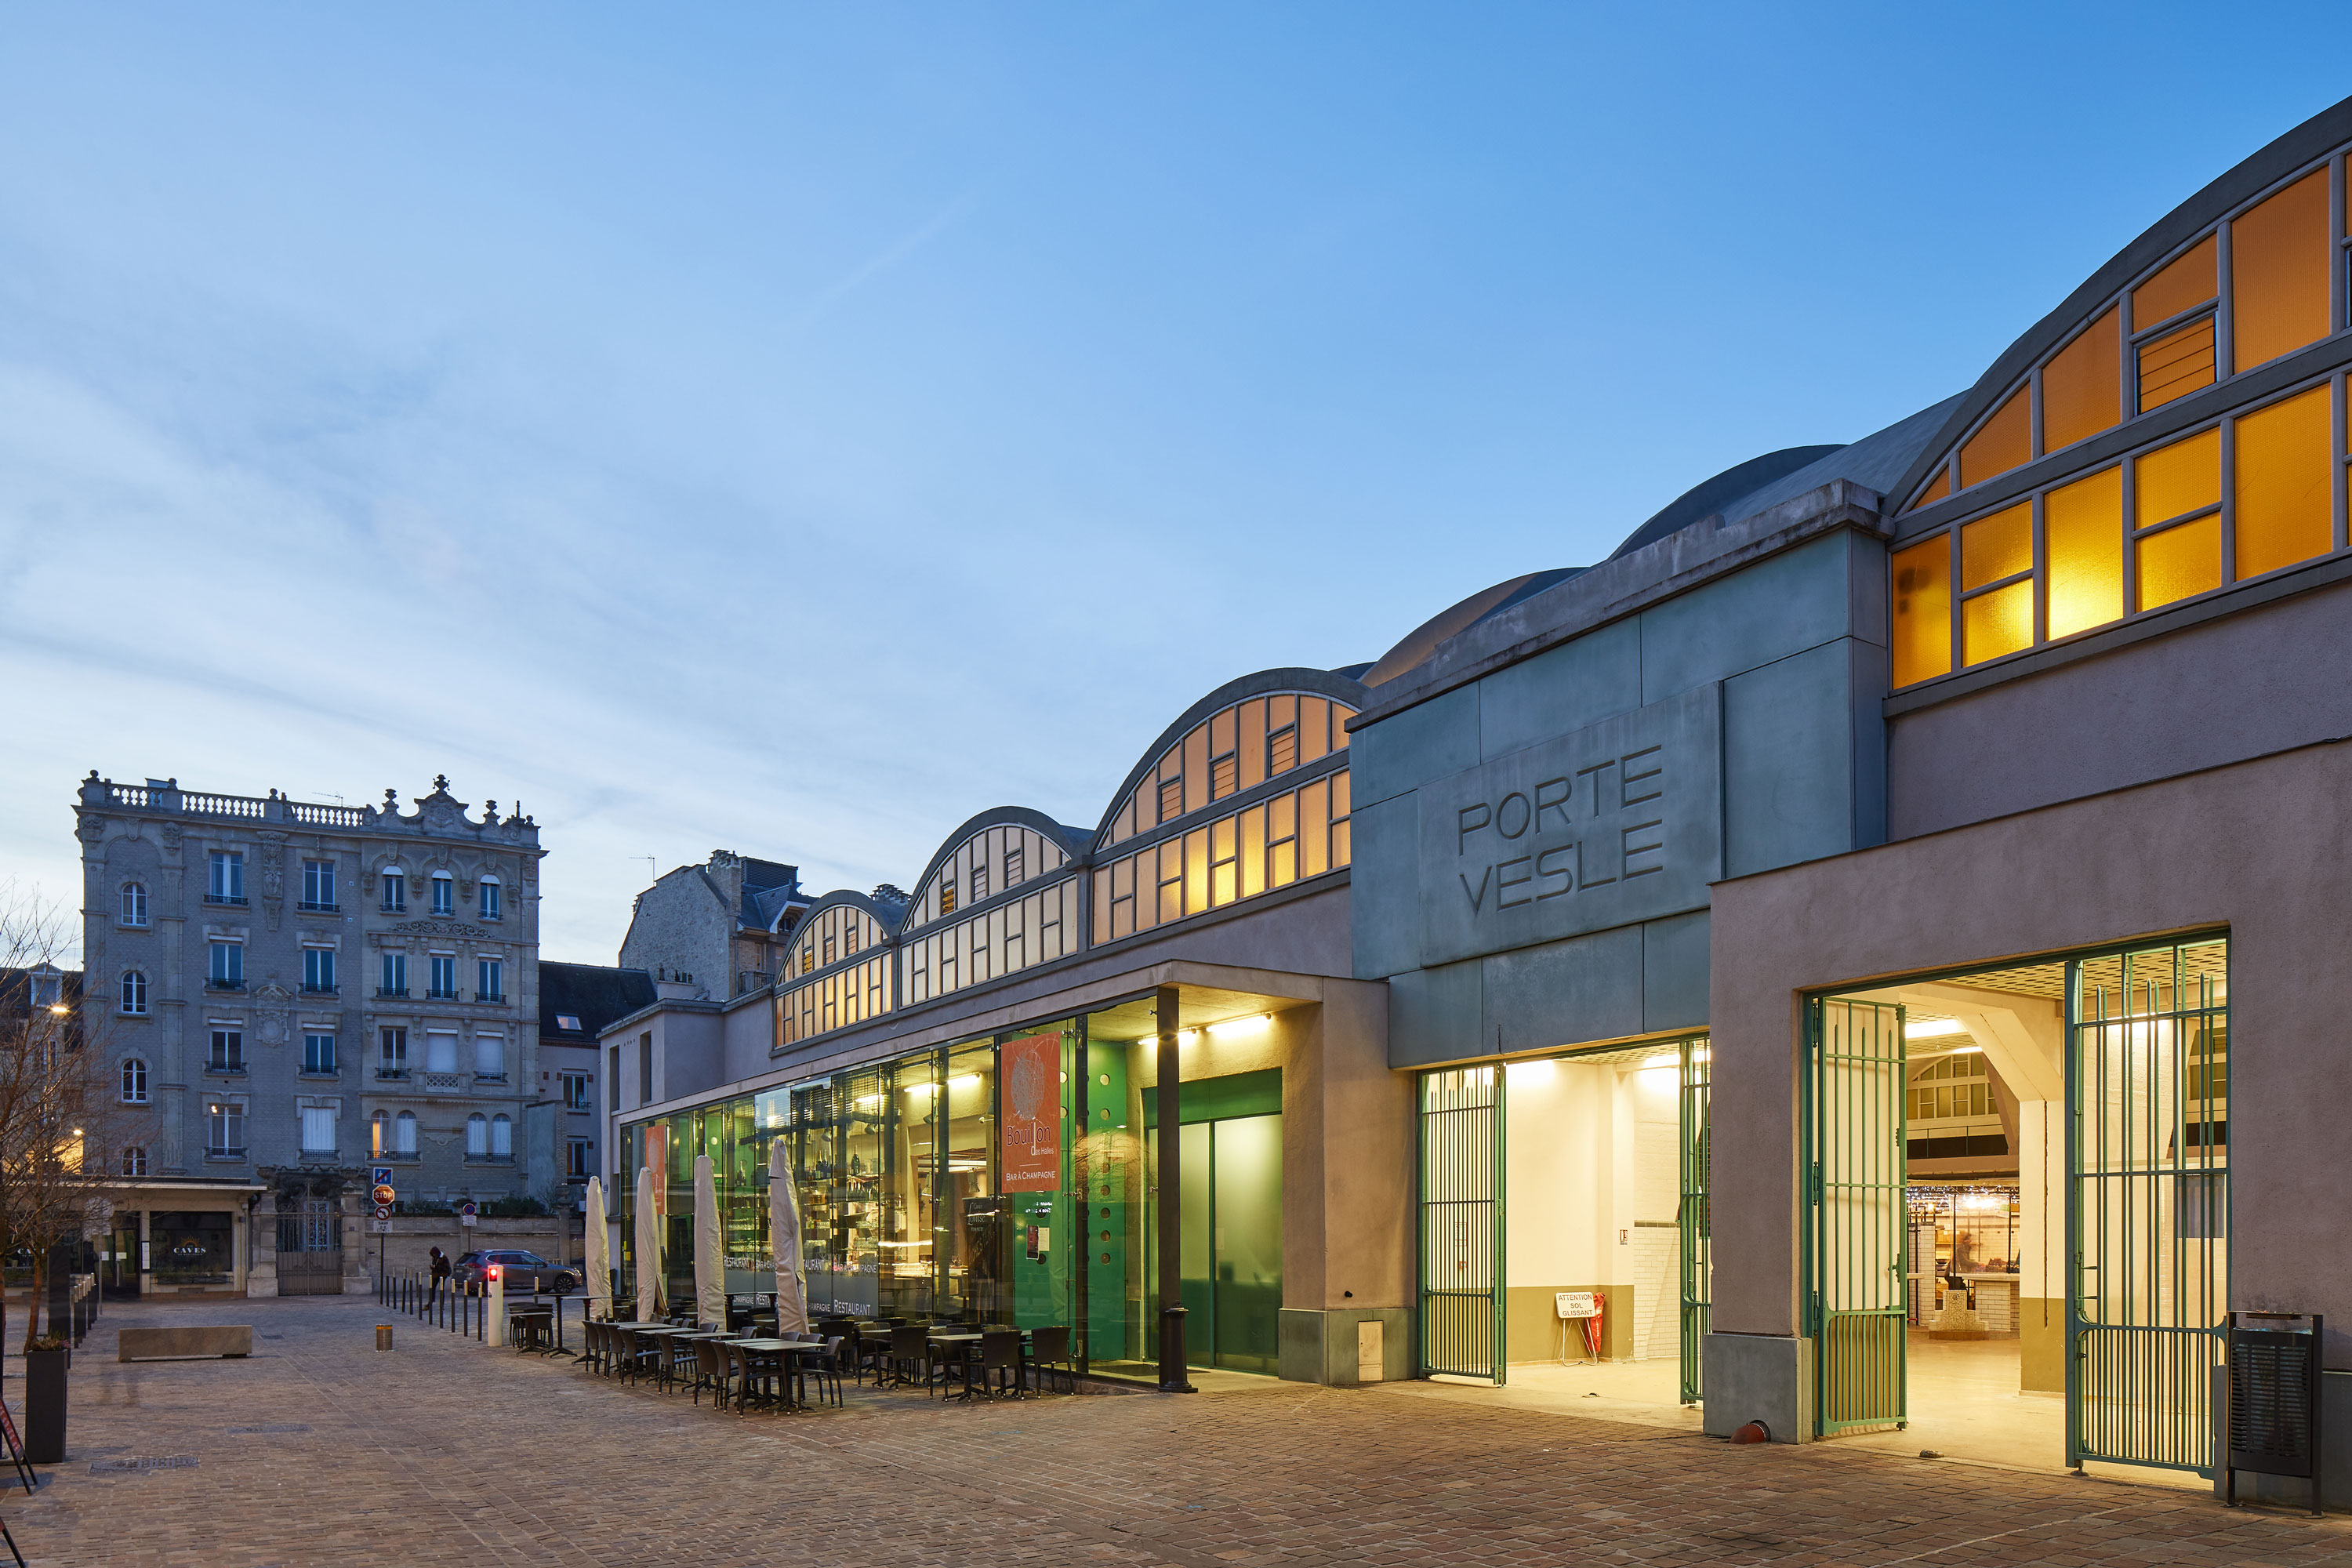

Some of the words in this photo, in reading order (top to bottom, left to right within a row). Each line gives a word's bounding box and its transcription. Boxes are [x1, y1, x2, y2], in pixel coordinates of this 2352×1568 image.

[1458, 744, 1662, 857] PORTE
[1459, 818, 1664, 915] VESLE
[1007, 1122, 1051, 1147] Bouillon
[1006, 1172, 1017, 1181] BAR
[1018, 1171, 1022, 1180] À
[1022, 1171, 1056, 1180] CHAMPAGNE
[808, 1302, 831, 1312] HAMPAGNE
[833, 1298, 871, 1316] RESTAURANT
